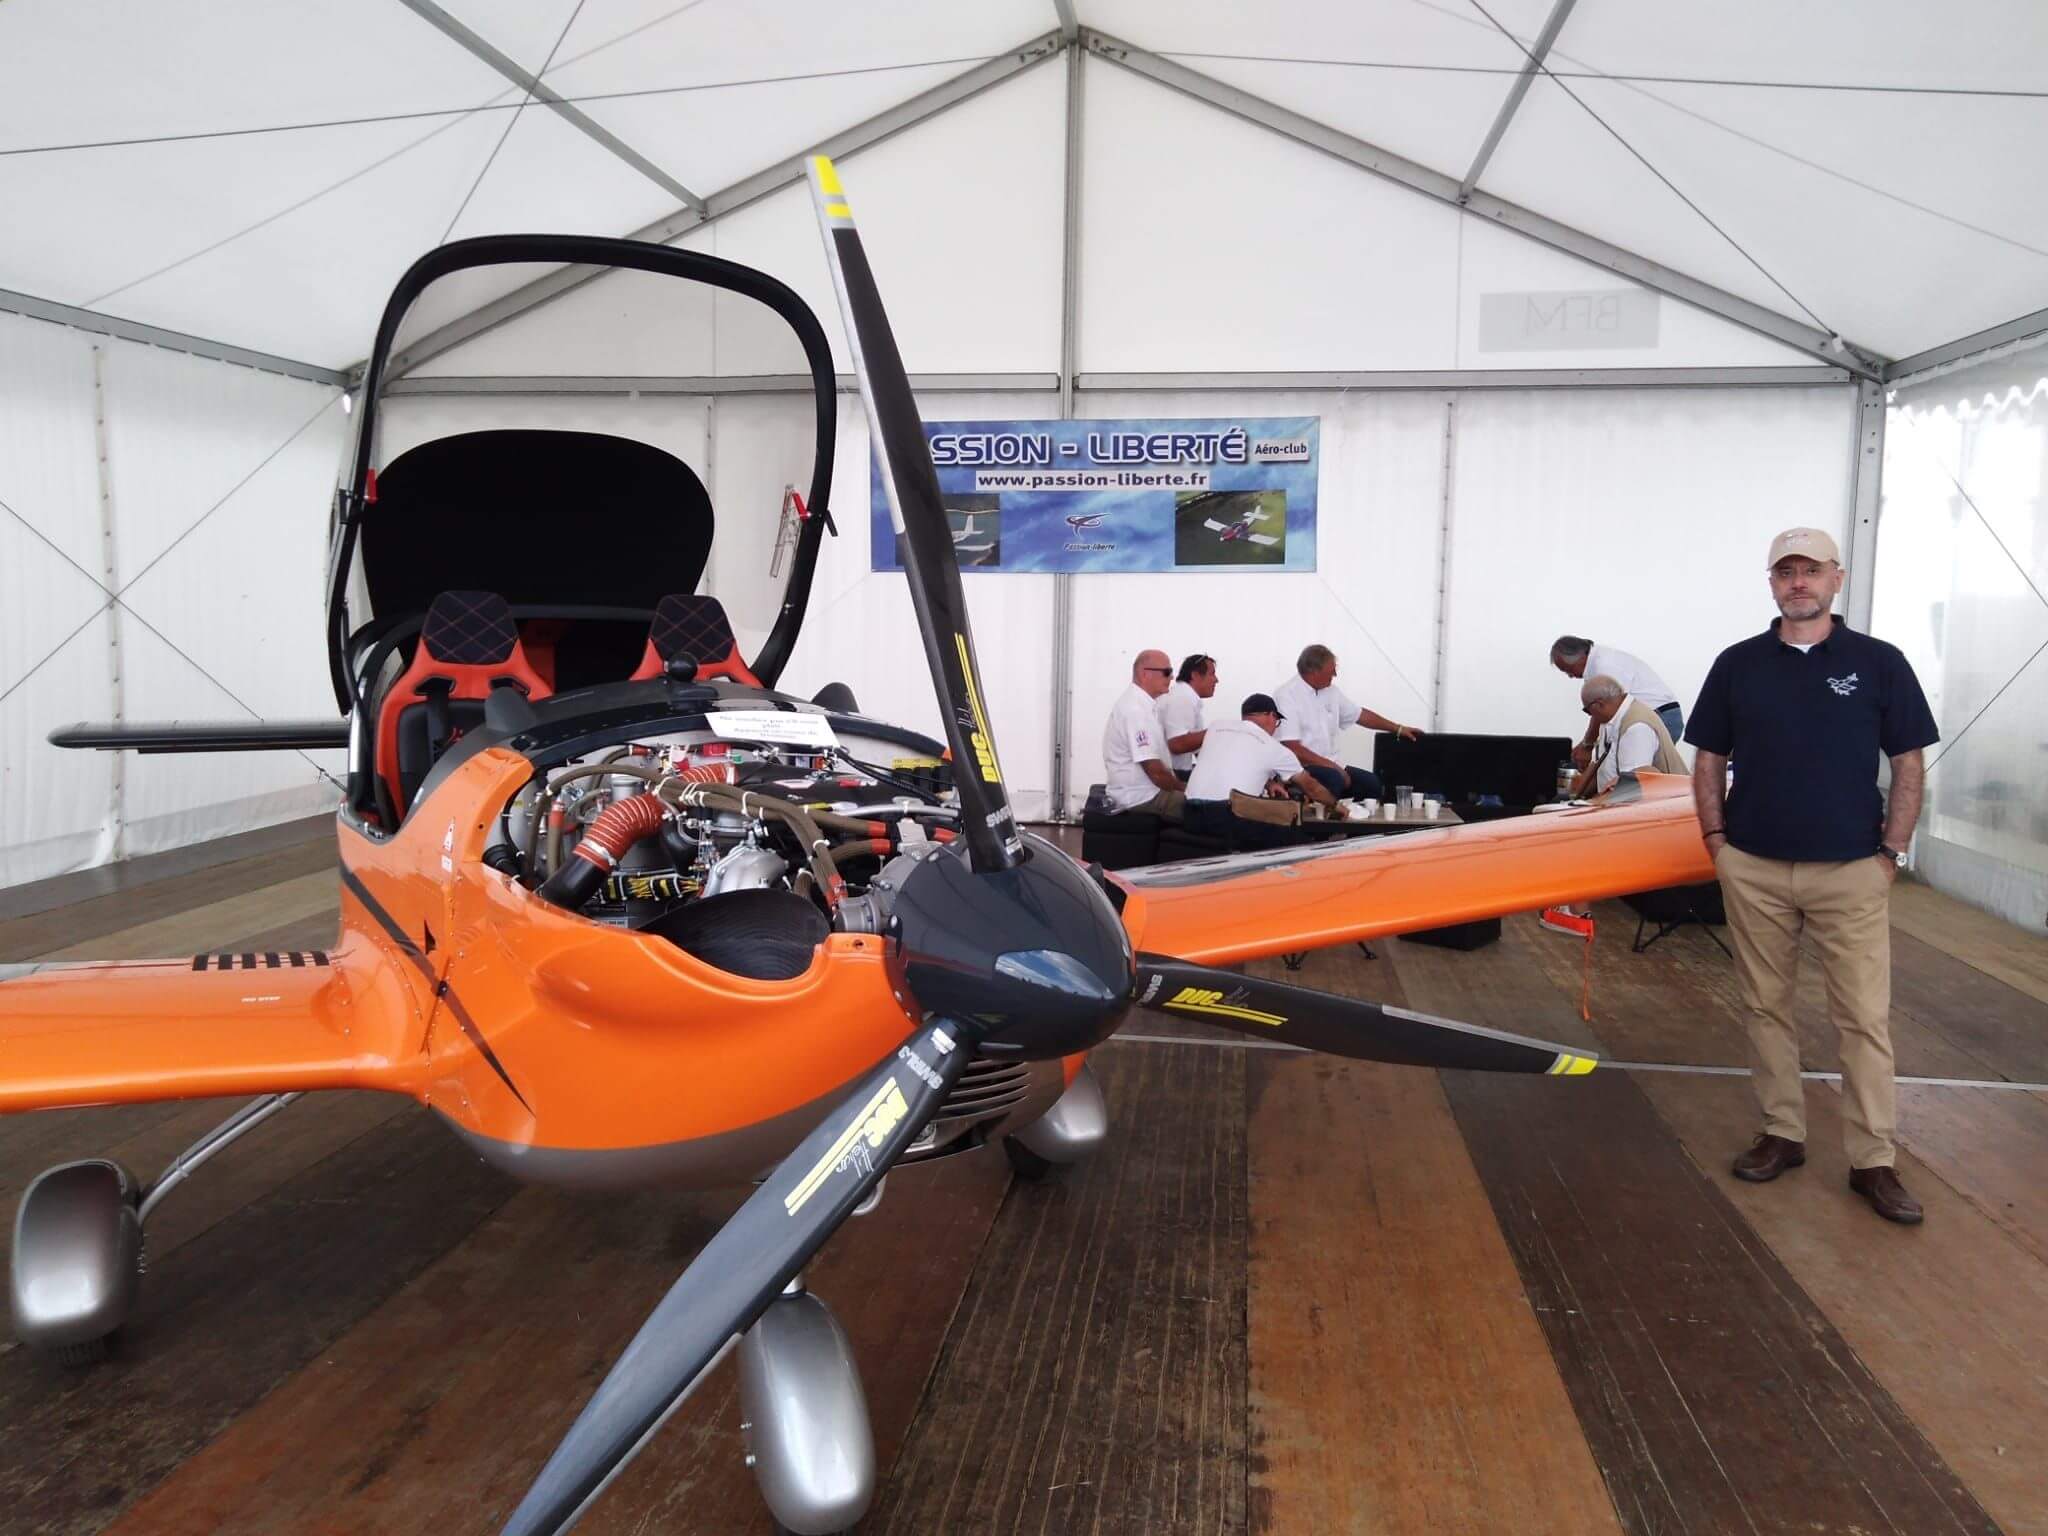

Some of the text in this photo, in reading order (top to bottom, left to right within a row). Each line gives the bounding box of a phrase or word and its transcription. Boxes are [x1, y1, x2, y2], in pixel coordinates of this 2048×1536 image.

[930, 433, 1050, 465] SSION
[1088, 426, 1247, 463] LIBERTÉ
[1254, 443, 1308, 455] Aéro-club
[978, 473, 1208, 488] www.passion-liberte.fr
[970, 732, 1001, 783] DUC
[1171, 987, 1223, 1006] DUC
[862, 1086, 909, 1148] DUC
